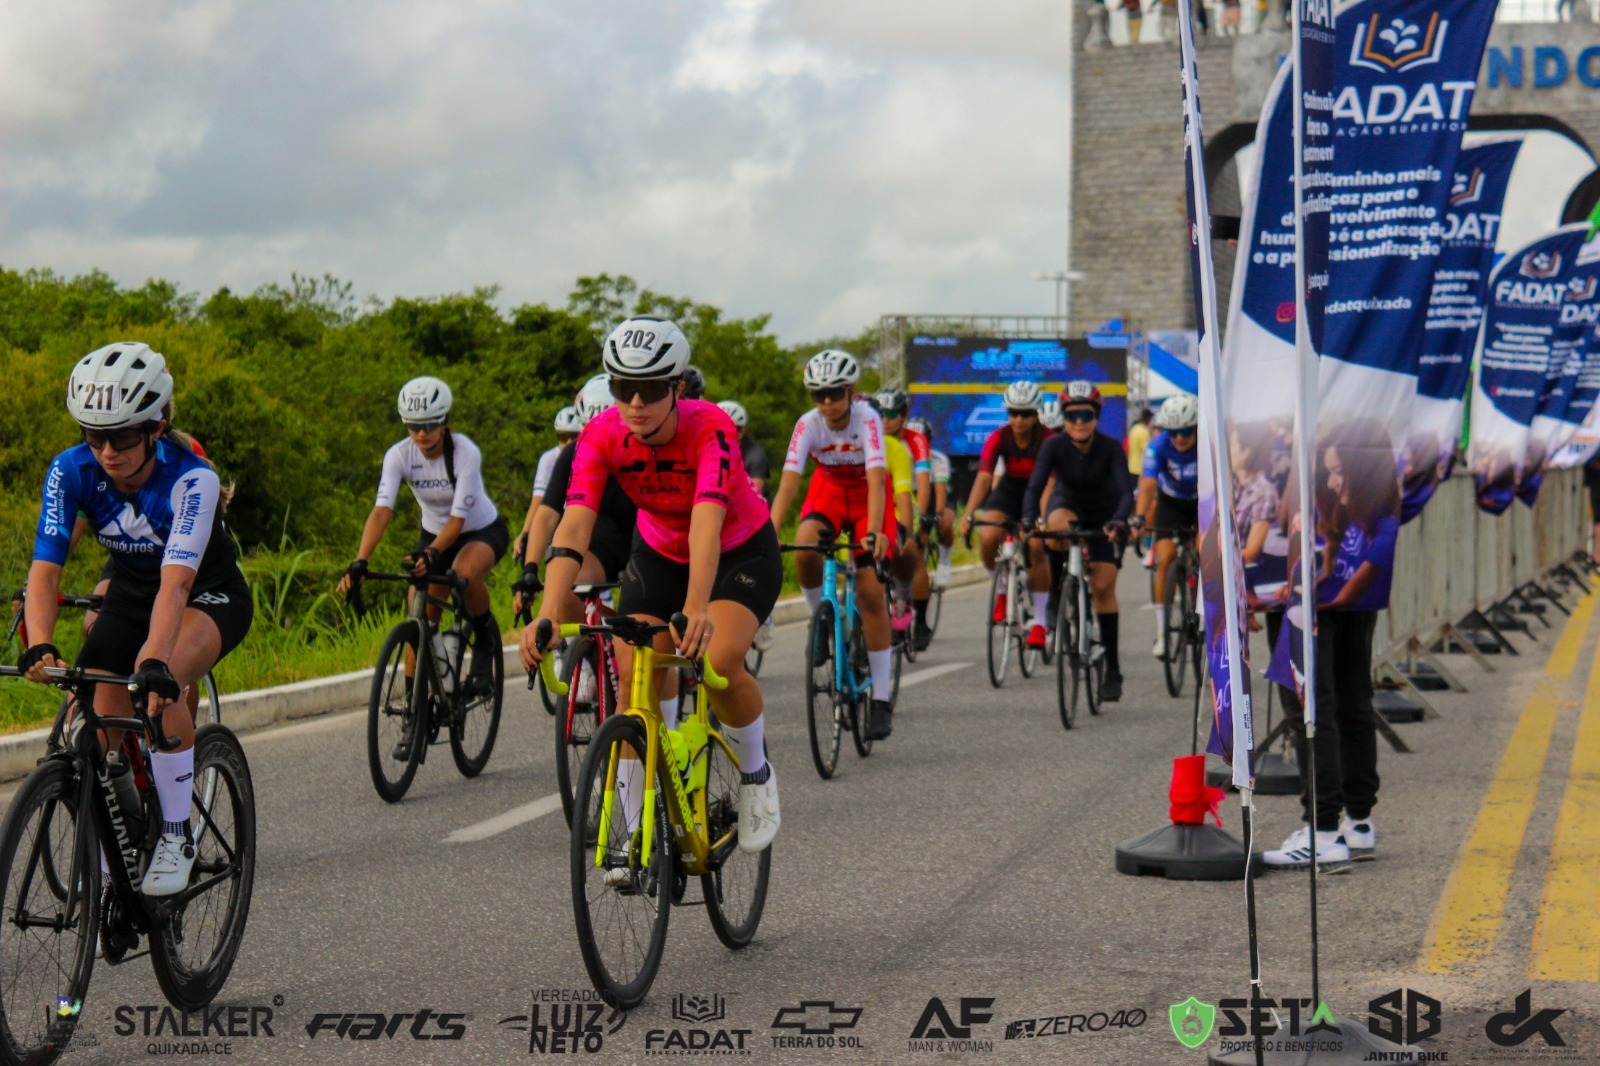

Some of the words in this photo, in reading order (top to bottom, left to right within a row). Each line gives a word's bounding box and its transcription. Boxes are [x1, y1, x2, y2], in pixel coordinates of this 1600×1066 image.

[1488, 46, 1600, 89] NDO
[1332, 81, 1477, 125] ADAT
[1336, 125, 1383, 138] AÇÃO
[1331, 170, 1395, 188] minho
[1397, 165, 1442, 184] mais
[1331, 193, 1360, 206] caz
[1362, 188, 1405, 208] para
[1406, 187, 1419, 200] o
[1338, 227, 1350, 242] é
[1351, 230, 1365, 242] a
[1443, 212, 1501, 241] DAT
[1253, 252, 1264, 265] e
[1266, 251, 1278, 265] a
[1495, 281, 1567, 305] FADAT
[1325, 296, 1412, 314] datquixada
[1560, 304, 1600, 323] DAT
[621, 329, 656, 351] 202
[84, 383, 114, 411] 211
[407, 397, 428, 412] 204
[421, 479, 450, 489] ZERO
[638, 485, 682, 495] TEAM
[44, 467, 64, 536] STALKER
[659, 721, 694, 832] cannondale
